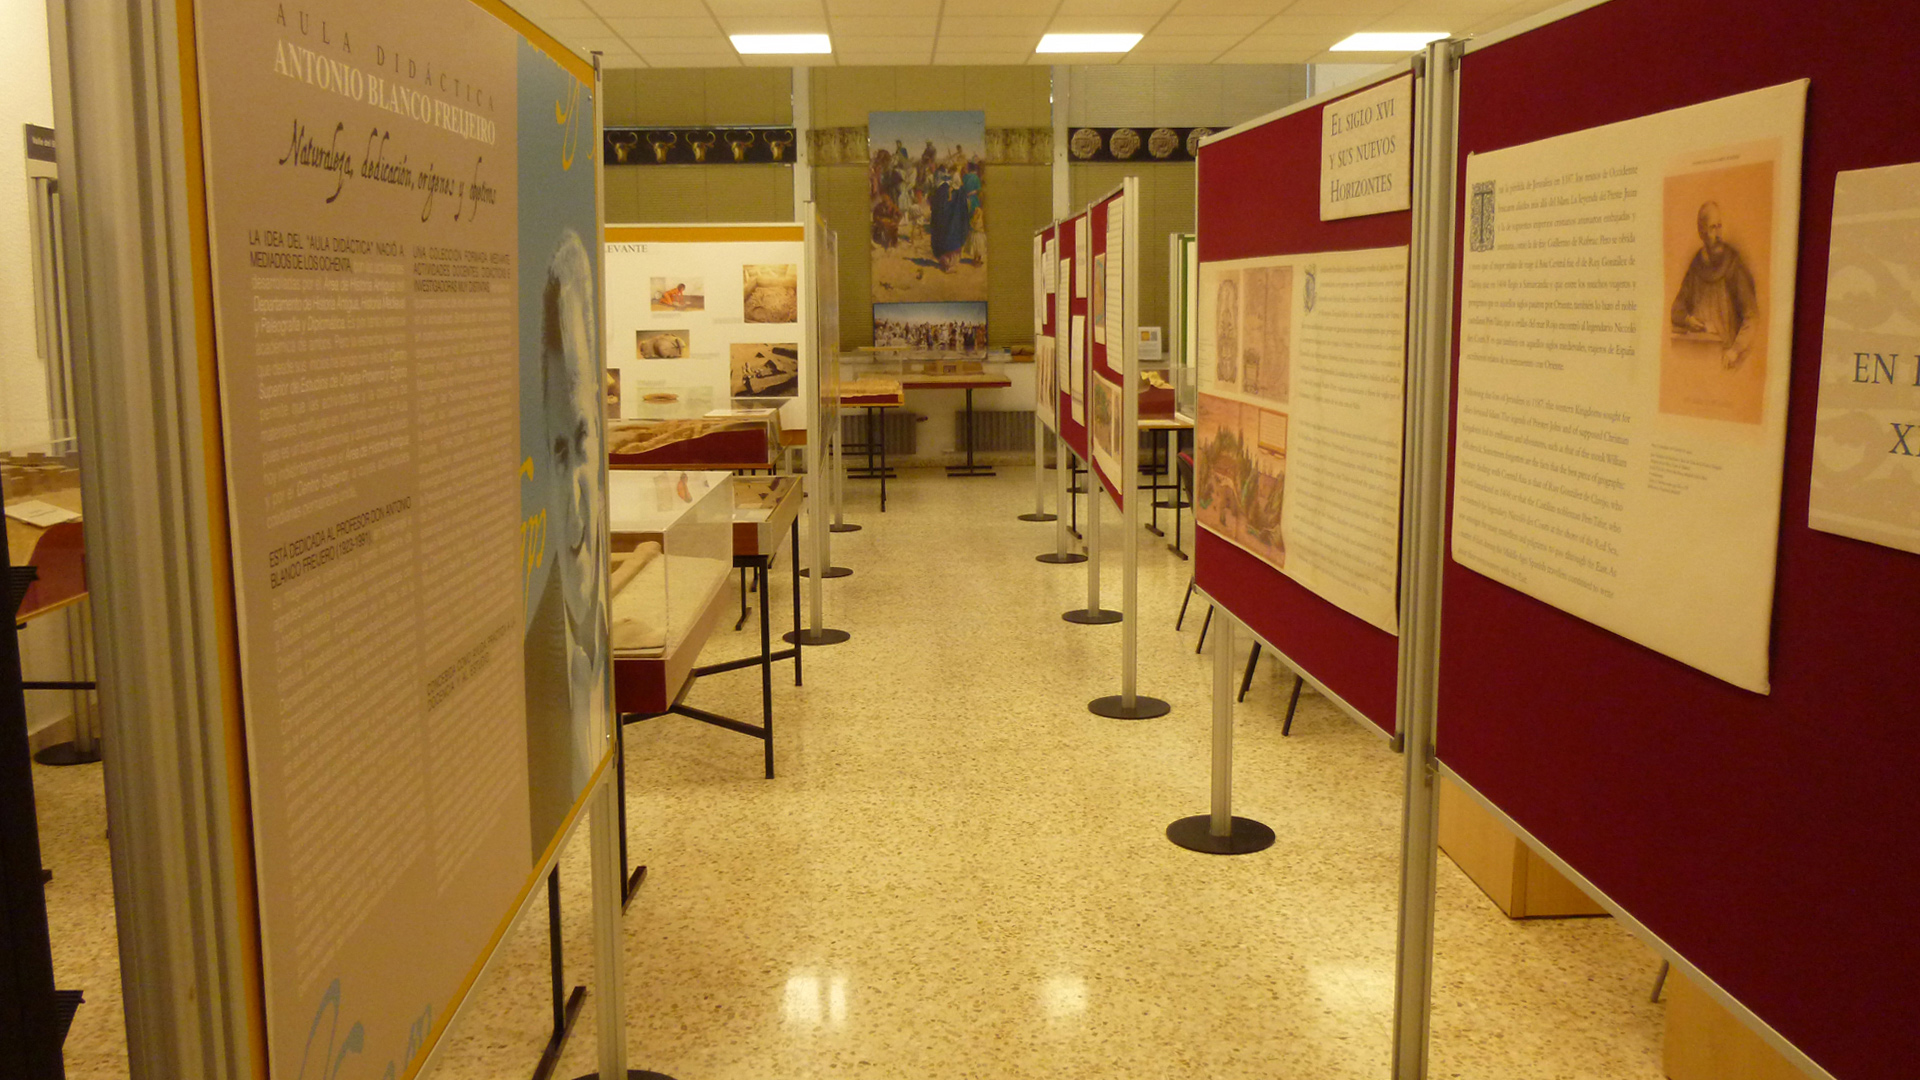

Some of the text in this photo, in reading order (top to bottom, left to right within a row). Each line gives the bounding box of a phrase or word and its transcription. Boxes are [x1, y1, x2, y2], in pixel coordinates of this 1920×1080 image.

[276, 2, 351, 54] AULA
[274, 39, 364, 101] ANTONIO
[367, 73, 431, 124] BLANCO
[1345, 105, 1373, 132] SIGLO
[1376, 98, 1395, 121] XVI
[1338, 147, 1354, 168] SUS
[1356, 134, 1396, 163] NUEVOS
[249, 229, 260, 246] LA
[264, 230, 284, 248] IDEA
[287, 232, 304, 250] DEL
[605, 244, 648, 254] EVANTE
[250, 251, 292, 270] MEDIADOS
[292, 254, 304, 270] DE
[304, 255, 319, 271] LOS
[1852, 352, 1898, 385] EN
[289, 530, 326, 560] DEDICADA
[270, 560, 301, 590] BLANCO
